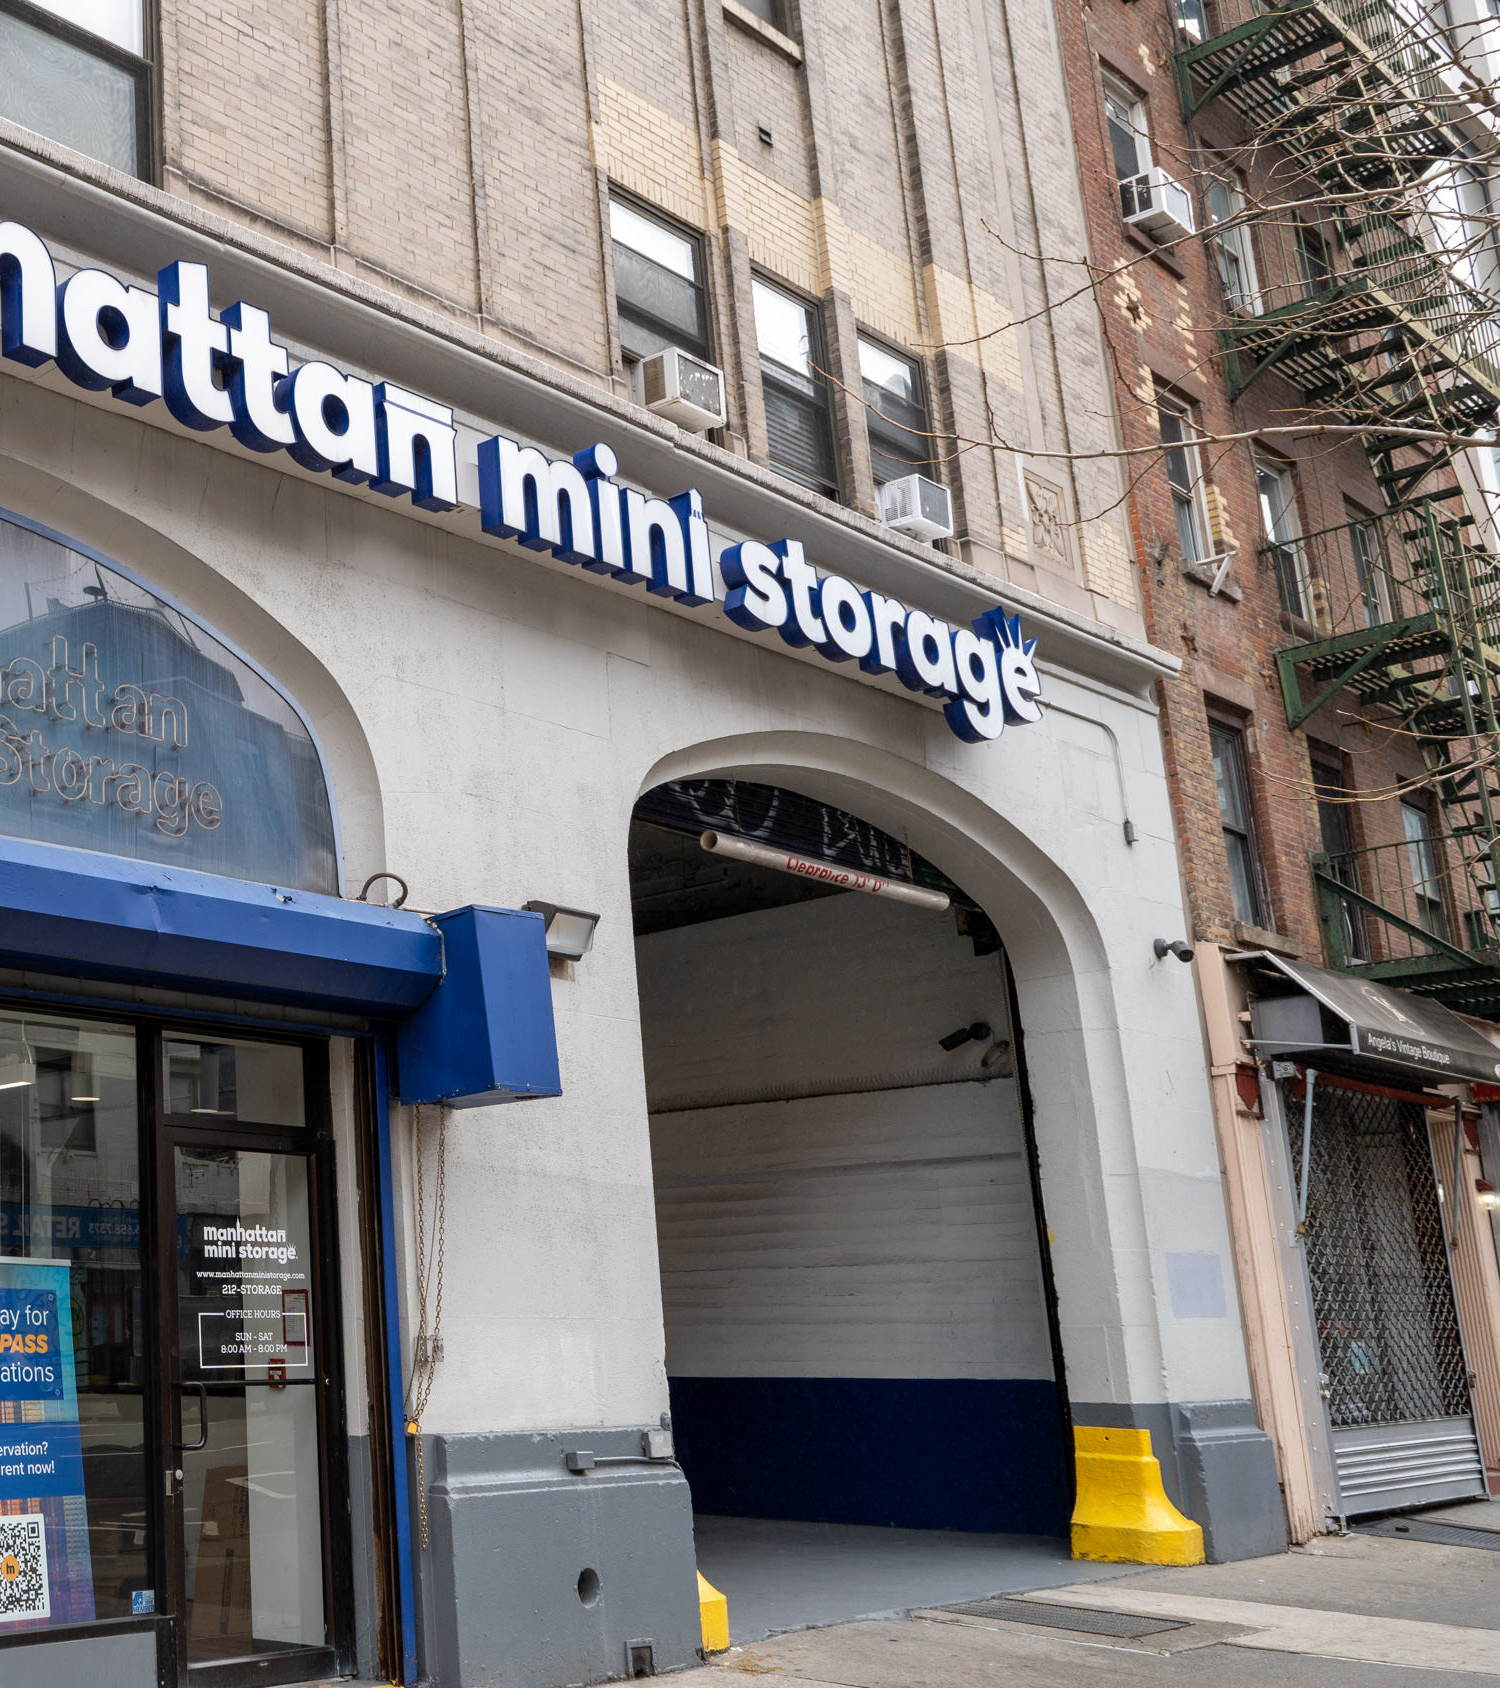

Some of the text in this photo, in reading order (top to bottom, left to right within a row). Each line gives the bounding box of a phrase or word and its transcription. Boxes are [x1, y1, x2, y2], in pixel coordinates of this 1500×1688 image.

[478, 443, 714, 607] mini
[722, 538, 1043, 744] storage
[786, 856, 849, 884] Clearance
[1368, 1032, 1451, 1066] Angela's Vintage Boutique
[203, 1216, 286, 1243] manhattan
[204, 1242, 297, 1264] mini storage
[196, 1270, 305, 1281] www.manhattanministorage.com
[222, 1284, 282, 1295] 212-STORAGE
[25, 1305, 49, 1326] for
[226, 1310, 281, 1319] OFFICE HOURS
[0, 1334, 48, 1354] PASS
[235, 1333, 252, 1341] SUN
[258, 1332, 273, 1341] SAT
[221, 1345, 238, 1353] 8:00
[238, 1344, 252, 1353] AM
[258, 1344, 275, 1353] 8:00
[276, 1344, 288, 1353] PM
[0, 1462, 25, 1476] rent
[27, 1460, 55, 1475] now!
